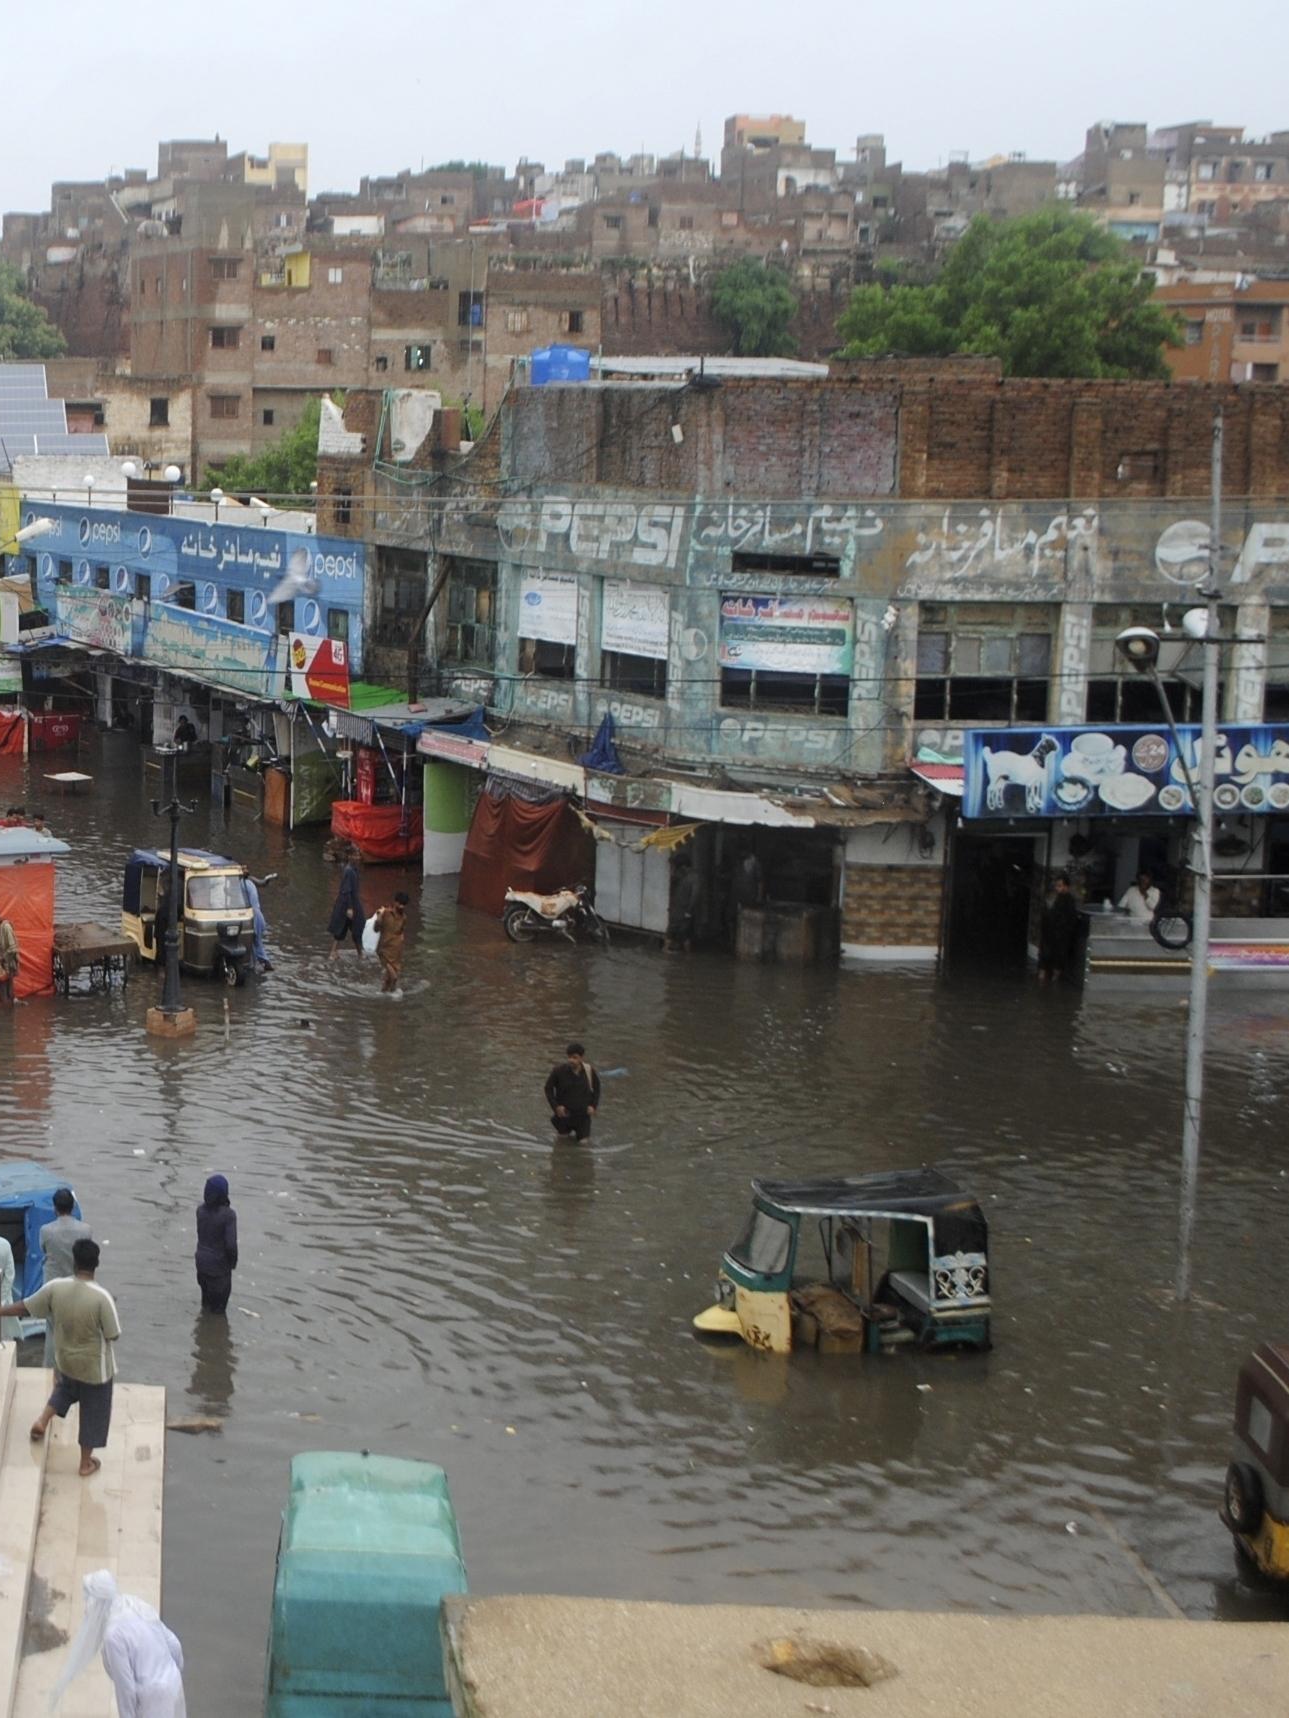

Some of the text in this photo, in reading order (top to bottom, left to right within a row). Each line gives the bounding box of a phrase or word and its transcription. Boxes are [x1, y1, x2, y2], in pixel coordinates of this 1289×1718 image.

[91, 520, 121, 546] pepsi
[313, 551, 357, 580] pepsi
[537, 495, 687, 568] PEPSI
[576, 586, 590, 678] PEPSI
[669, 611, 684, 711] PEPSI
[852, 609, 877, 703] PEPSI
[1060, 612, 1087, 716] PEPSI
[611, 702, 661, 727] PEPSI
[742, 721, 837, 749] PEPSI
